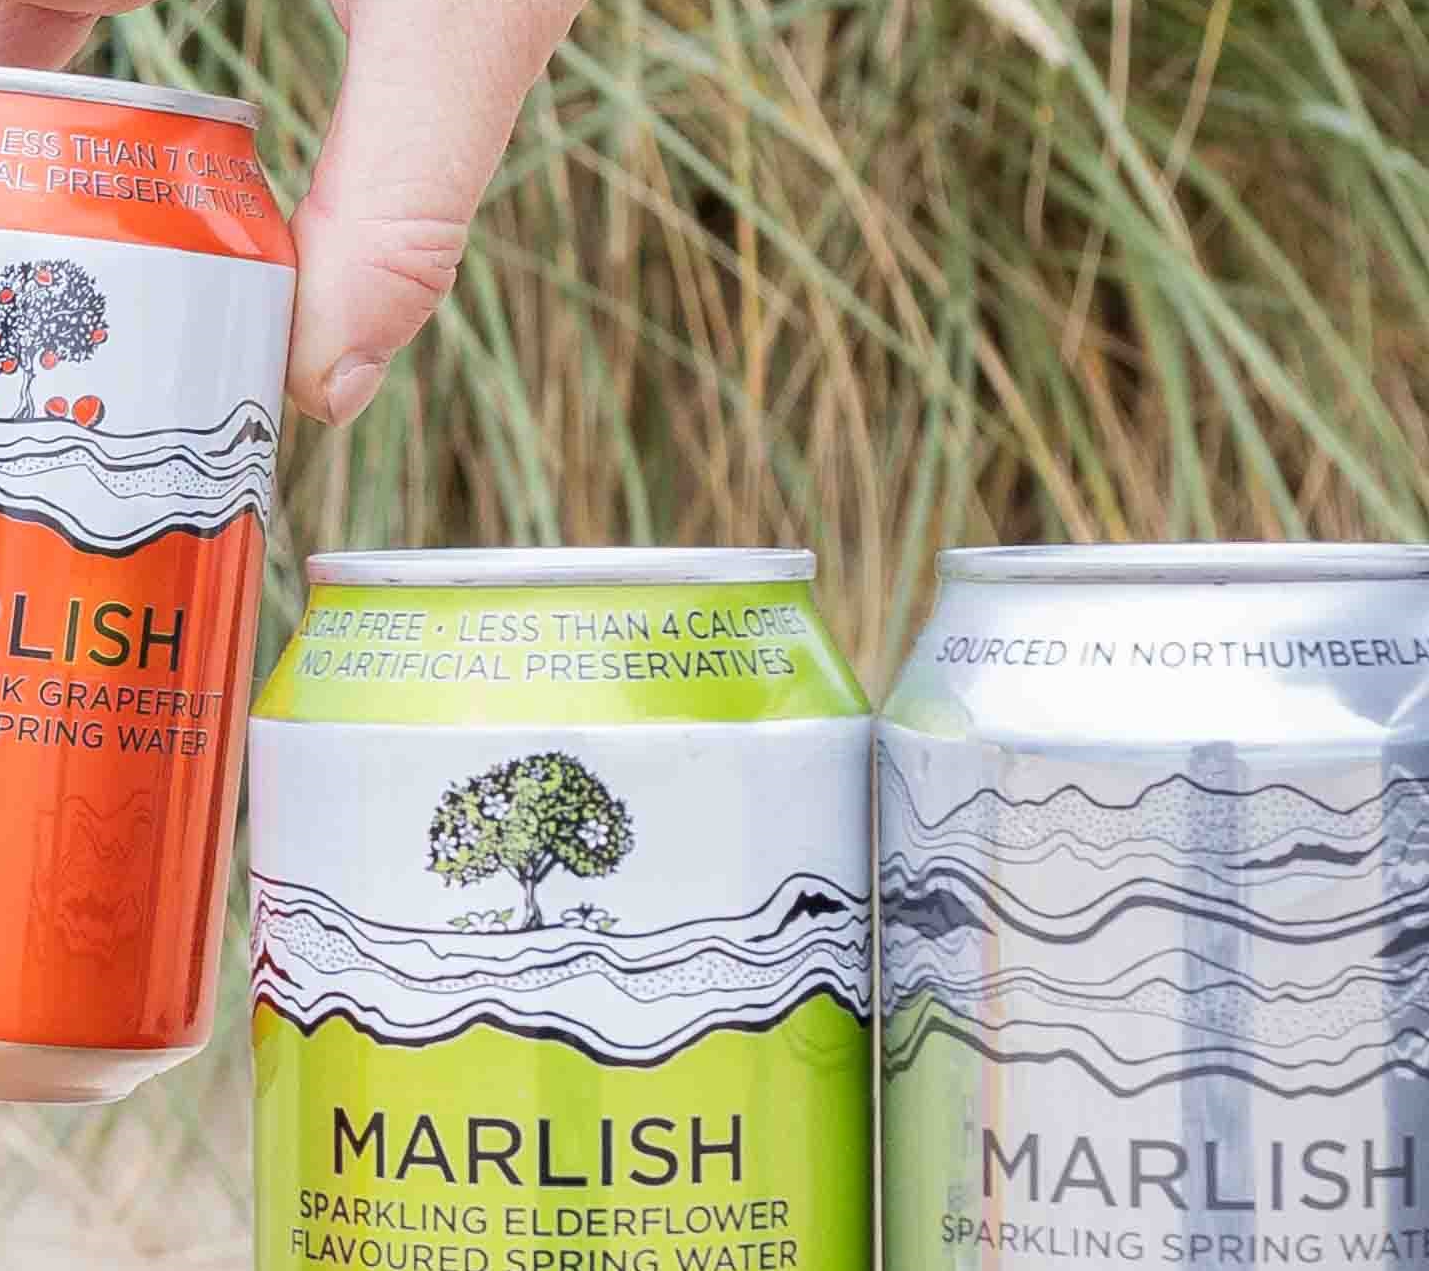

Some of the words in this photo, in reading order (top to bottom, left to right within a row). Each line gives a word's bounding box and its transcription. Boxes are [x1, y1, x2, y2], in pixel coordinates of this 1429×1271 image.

[71, 134, 157, 170] THAN
[164, 148, 179, 171] 7
[46, 166, 264, 218] PRESERVATIVES
[353, 612, 426, 641] FREE
[459, 614, 540, 642] LESS
[551, 613, 649, 642] THAN
[662, 610, 681, 639] 4
[687, 607, 806, 639] CALORIES
[297, 649, 332, 676] NO
[334, 652, 511, 681] ARTIFICIAL
[525, 648, 794, 680] PRESERVATIVES
[937, 635, 1067, 667] SOURCED
[1078, 640, 1115, 667] IN
[38, 679, 222, 719] GRAPEFRUIT
[116, 725, 207, 756] WATER
[332, 1106, 742, 1187] MARLISH
[981, 1127, 1415, 1211] MARLISH
[300, 1188, 487, 1235] SPARKLING
[505, 1199, 789, 1238] ELDERFLOWER
[941, 1213, 1144, 1261] SPARKLING
[1160, 1232, 1324, 1264] SPRING
